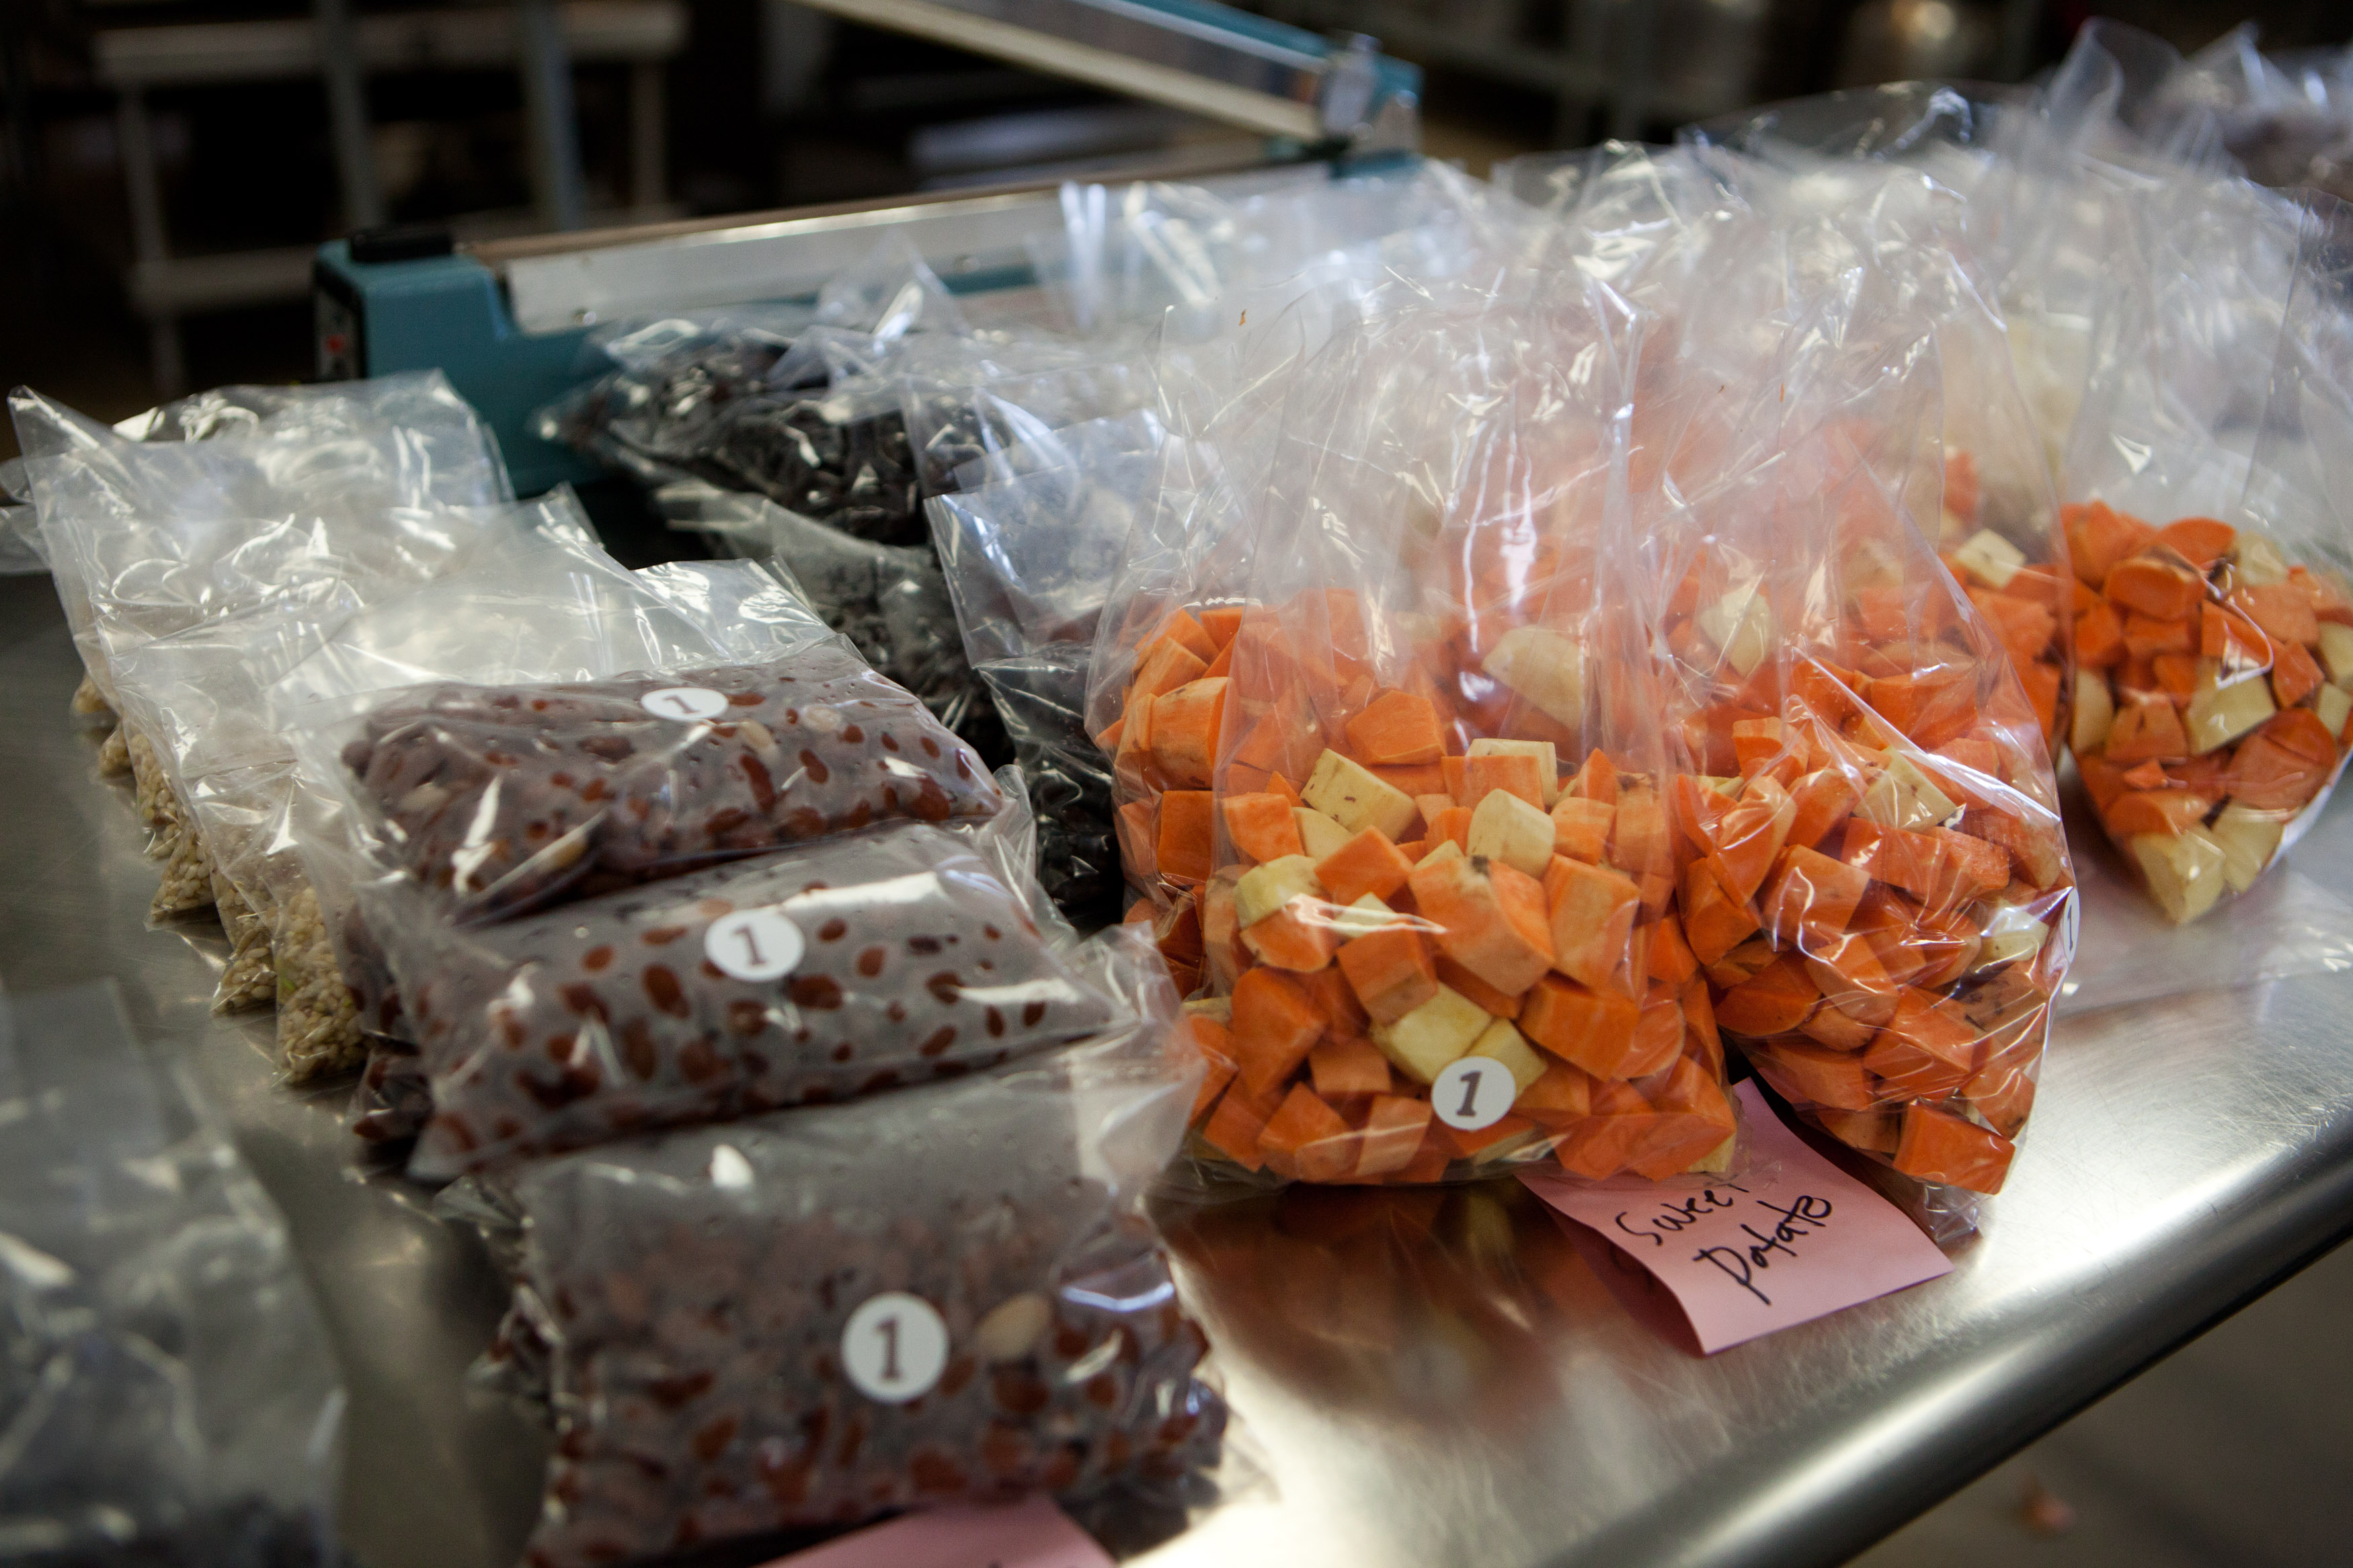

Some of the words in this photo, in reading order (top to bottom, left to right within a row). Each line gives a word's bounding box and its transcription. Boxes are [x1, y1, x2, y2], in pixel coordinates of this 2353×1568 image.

[662, 694, 701, 714] 1
[733, 924, 768, 966] 1
[1455, 1069, 1483, 1117] 1
[875, 1316, 902, 1380] 1
